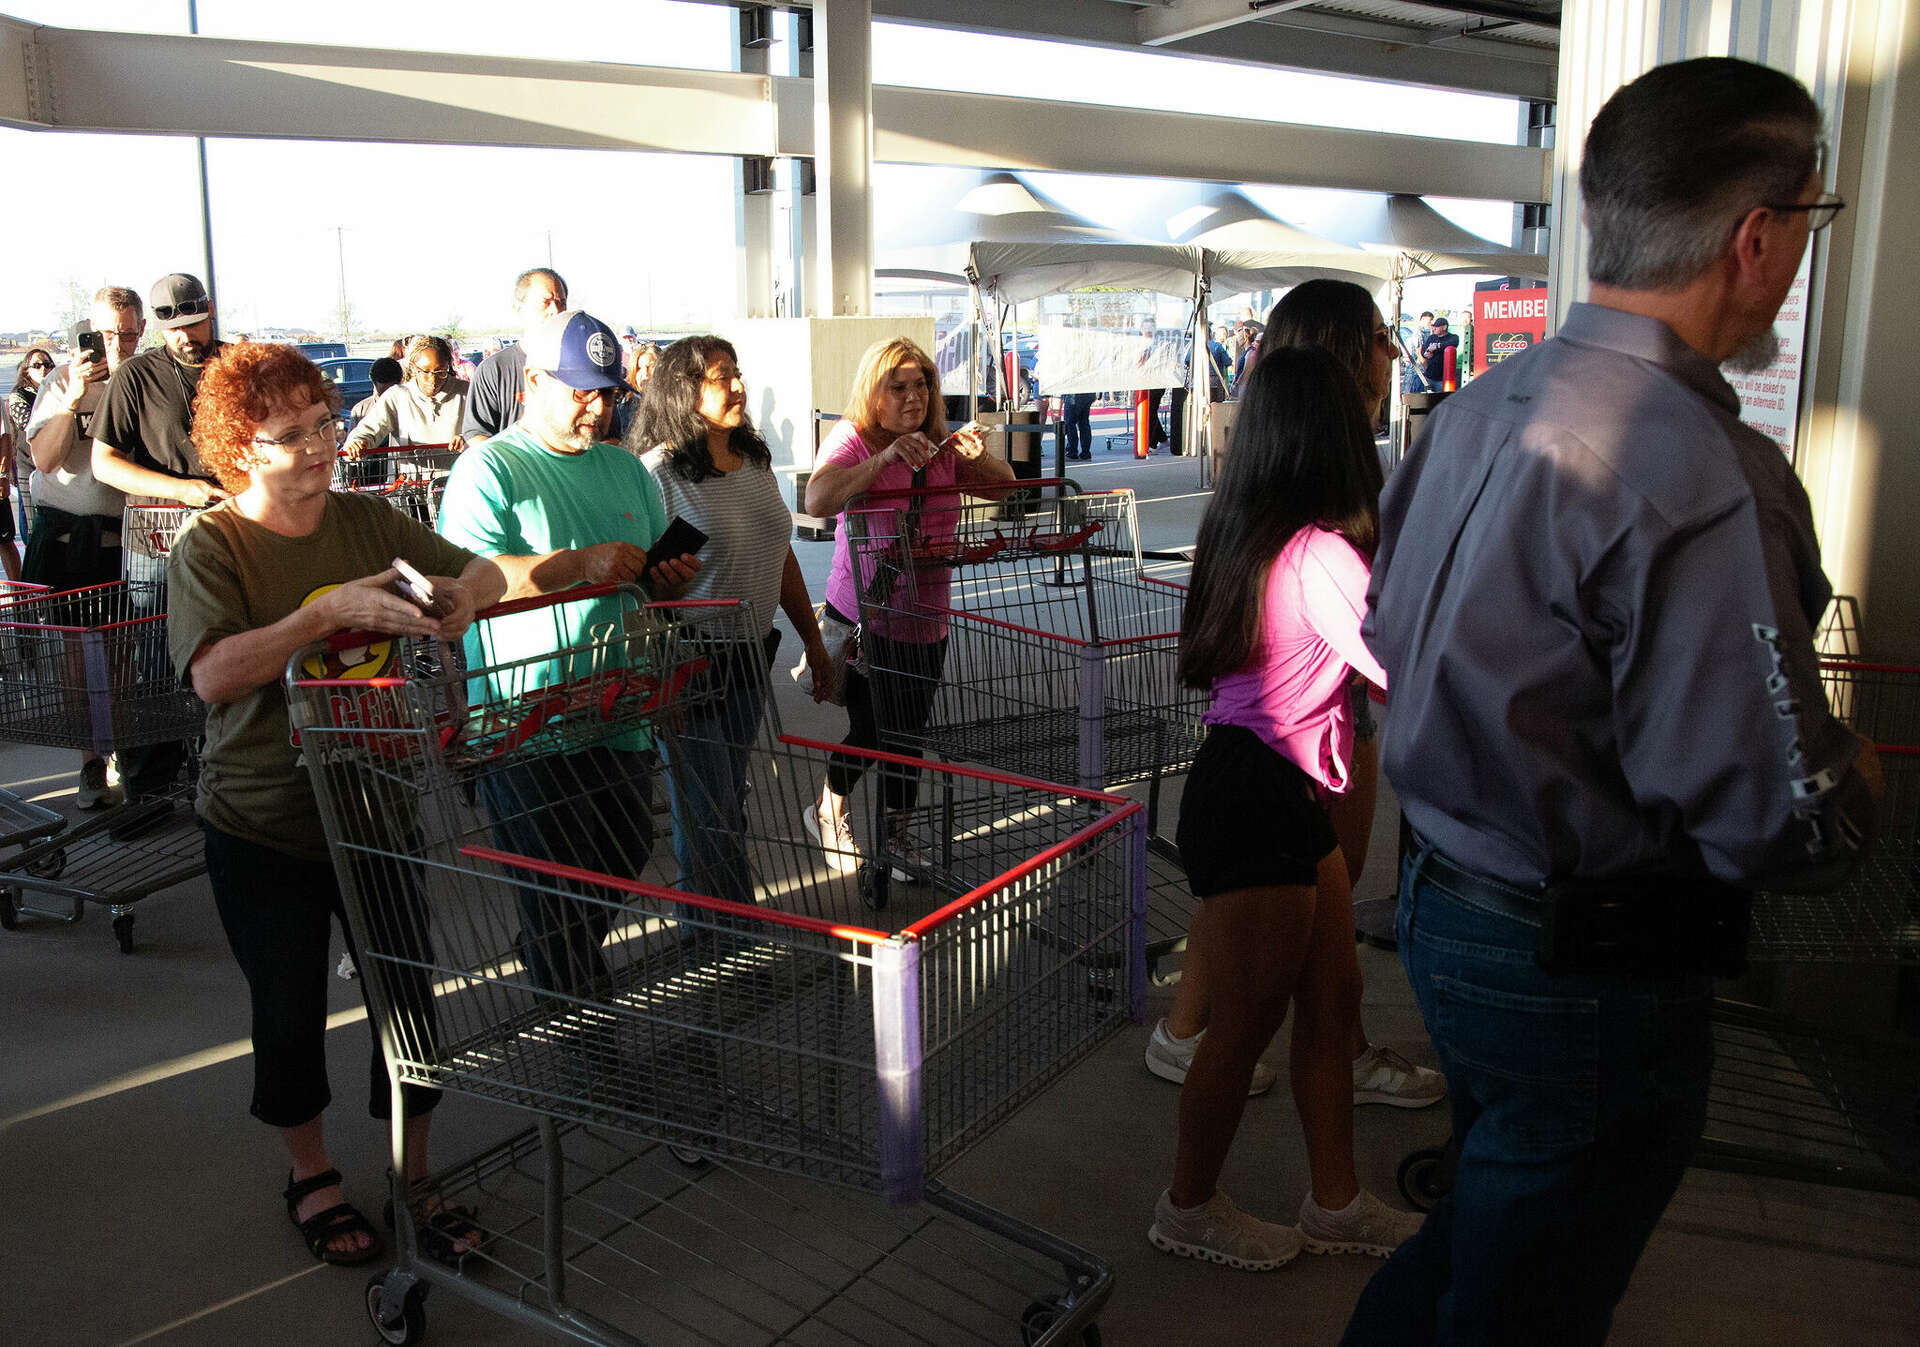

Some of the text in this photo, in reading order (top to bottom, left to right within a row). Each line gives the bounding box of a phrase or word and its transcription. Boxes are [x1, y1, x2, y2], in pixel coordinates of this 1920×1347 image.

[1493, 341, 1527, 349] COSTCO
[1779, 367, 1796, 380] photo
[1762, 381, 1779, 393] asked
